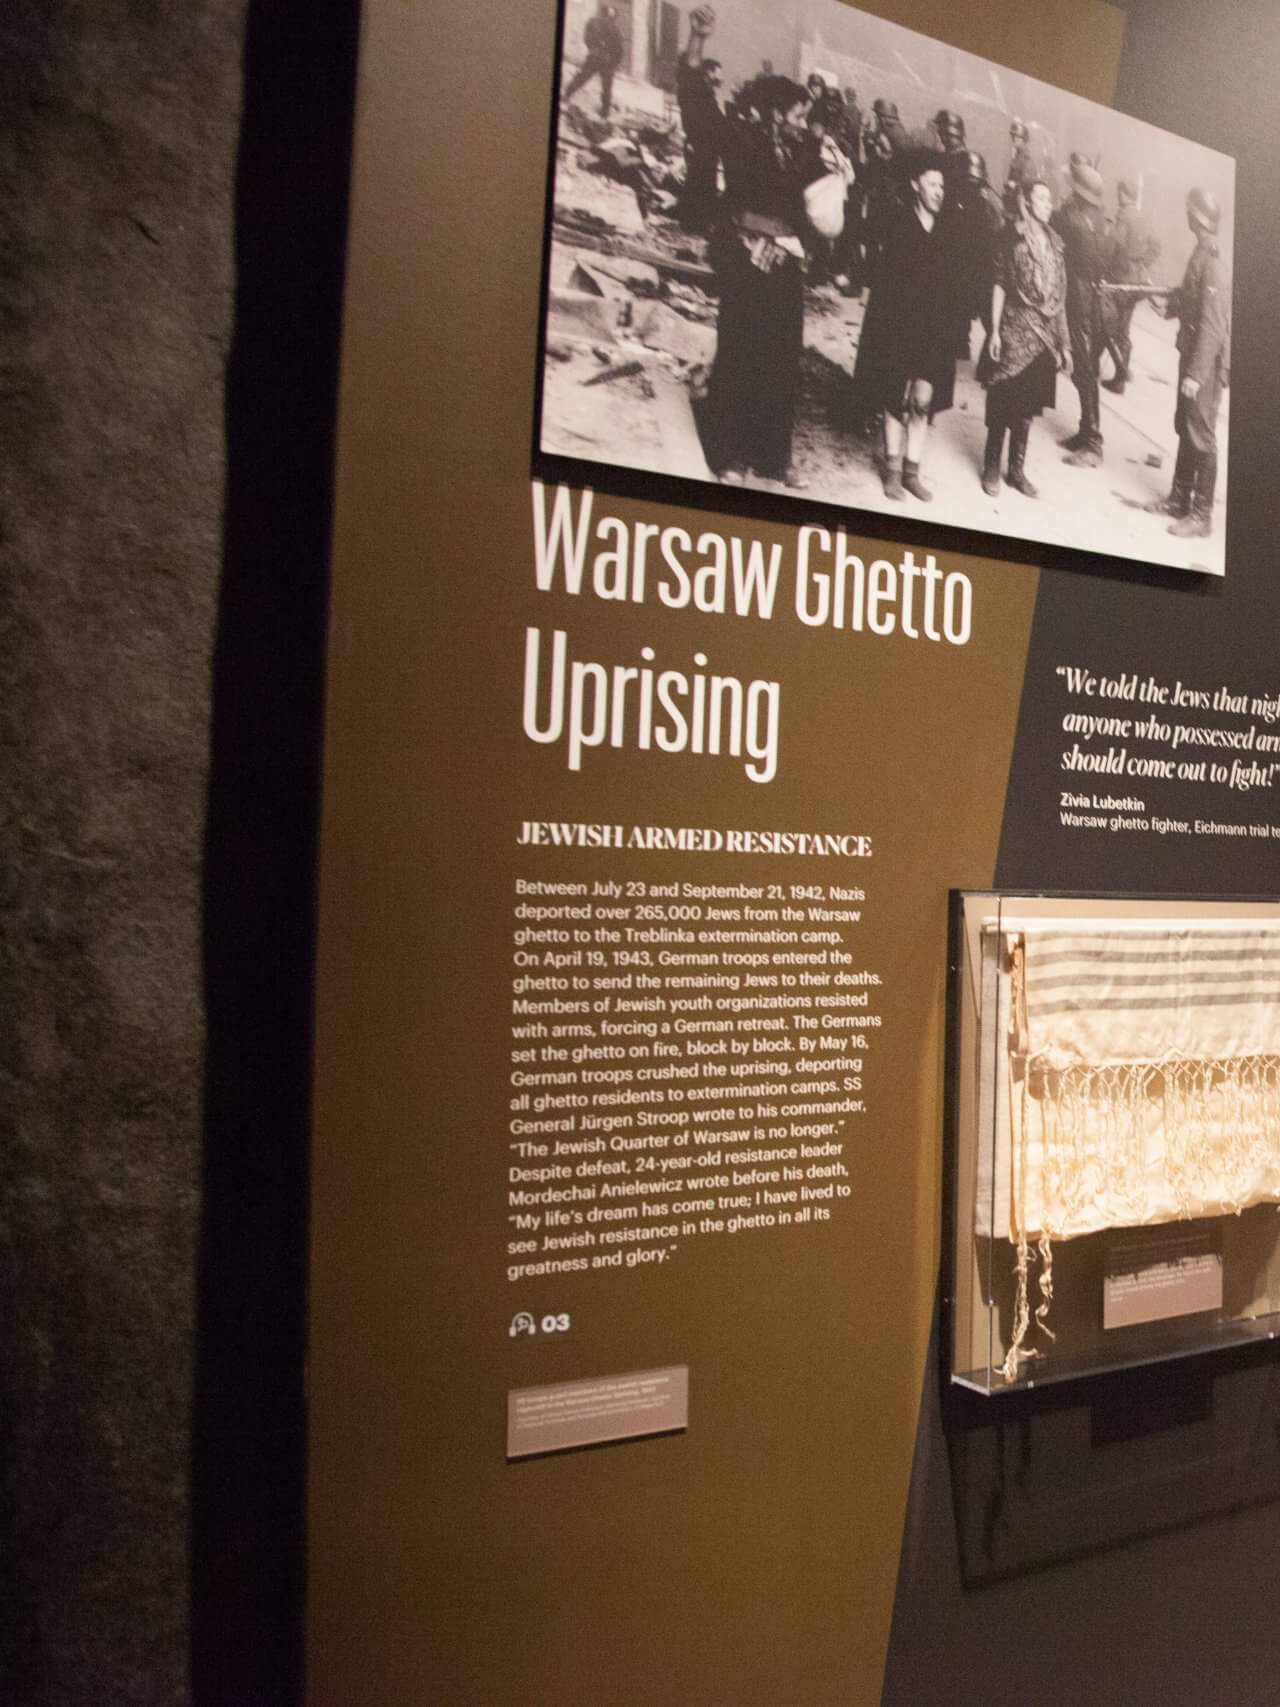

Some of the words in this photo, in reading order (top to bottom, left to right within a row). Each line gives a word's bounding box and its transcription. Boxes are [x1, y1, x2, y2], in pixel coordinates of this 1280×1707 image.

[530, 478, 782, 620] Warsaw
[795, 524, 973, 646] Ghetto
[522, 627, 780, 784] Uprising
[1099, 673, 1138, 701] told
[1138, 676, 1169, 705] the
[1170, 681, 1210, 709] Jews
[1212, 686, 1248, 714] that
[1062, 713, 1132, 740] anyone
[1134, 714, 1171, 741] who
[1171, 725, 1255, 750] possessed
[1060, 743, 1127, 774] should
[1126, 757, 1176, 779] come
[1177, 762, 1206, 781] out
[1209, 763, 1228, 782] to
[1060, 792, 1090, 808] Zivia
[1092, 794, 1145, 811] Lubetkin
[1059, 811, 1108, 828] Warsaw
[1109, 814, 1149, 832] ghetto
[1151, 816, 1192, 834] fighter,
[1194, 819, 1247, 836] Eichmann
[1249, 823, 1269, 837] trial
[517, 821, 623, 848] JEWISH
[627, 826, 723, 851] ARMED
[726, 830, 872, 857] RESISTANCE
[516, 879, 587, 895] Between
[591, 880, 623, 899] July
[626, 881, 646, 897] 23
[649, 881, 679, 897] and
[682, 882, 765, 901] September
[766, 884, 786, 901] 21,
[789, 884, 826, 902] 1942,
[829, 885, 866, 901] Nazis
[514, 902, 592, 921] deported
[595, 907, 631, 919] over
[634, 904, 702, 921] 265,000
[704, 905, 741, 921] Jews
[743, 905, 779, 921] from
[781, 905, 805, 922] the
[807, 906, 861, 922] Warsaw
[514, 926, 570, 945] ghetto
[573, 929, 591, 942] to
[594, 927, 621, 943] the
[624, 927, 695, 943] Treblinka
[697, 928, 798, 943] extermination
[800, 931, 844, 946] camp.
[513, 951, 539, 966] On
[543, 950, 582, 969] April
[586, 951, 607, 967] 19,
[612, 950, 654, 967] 1943,
[658, 950, 719, 966] German
[721, 951, 770, 968] troops
[771, 948, 827, 965] entered
[829, 948, 853, 965] the
[513, 974, 568, 993] ghetto
[572, 976, 590, 990] to
[593, 973, 632, 989] send
[635, 973, 662, 989] the
[664, 972, 740, 990] remaining
[742, 972, 779, 987] Jews
[780, 973, 797, 986] to
[798, 970, 832, 986] their
[833, 969, 883, 986] deaths.
[512, 997, 590, 1014] Members
[593, 996, 610, 1013] of
[614, 995, 666, 1012] Jewish
[669, 994, 713, 1014] youth
[715, 993, 812, 1012] organizations
[814, 991, 868, 1007] resisted
[511, 1022, 548, 1038] with
[551, 1024, 596, 1037] arms,
[600, 1019, 657, 1037] forcing
[660, 1022, 670, 1034] a
[673, 1018, 734, 1033] German
[736, 1016, 789, 1031] retreat.
[792, 1013, 819, 1029] The
[820, 1013, 882, 1029] Germans
[511, 1048, 536, 1062] set
[541, 1045, 568, 1061] the
[571, 1044, 626, 1063] ghetto
[628, 1045, 649, 1058] on
[653, 1041, 682, 1057] fire,
[686, 1038, 727, 1055] block
[730, 1038, 750, 1056] by
[752, 1036, 796, 1053] block.
[798, 1036, 817, 1053] By
[819, 1034, 848, 1052] May
[850, 1033, 869, 1050] 16,
[510, 1071, 577, 1086] German
[581, 1069, 633, 1084] troops
[636, 1062, 699, 1080] crushed
[702, 1061, 727, 1077] the
[730, 1058, 792, 1078] uprising,
[794, 1055, 863, 1075] deporting
[510, 1094, 529, 1110] all
[533, 1093, 589, 1112] ghetto
[592, 1088, 664, 1105] residents
[667, 1088, 684, 1102] to
[686, 1081, 788, 1100] extermination
[789, 1080, 840, 1095] camps.
[843, 1076, 863, 1091] SS
[541, 1314, 571, 1333] 03
